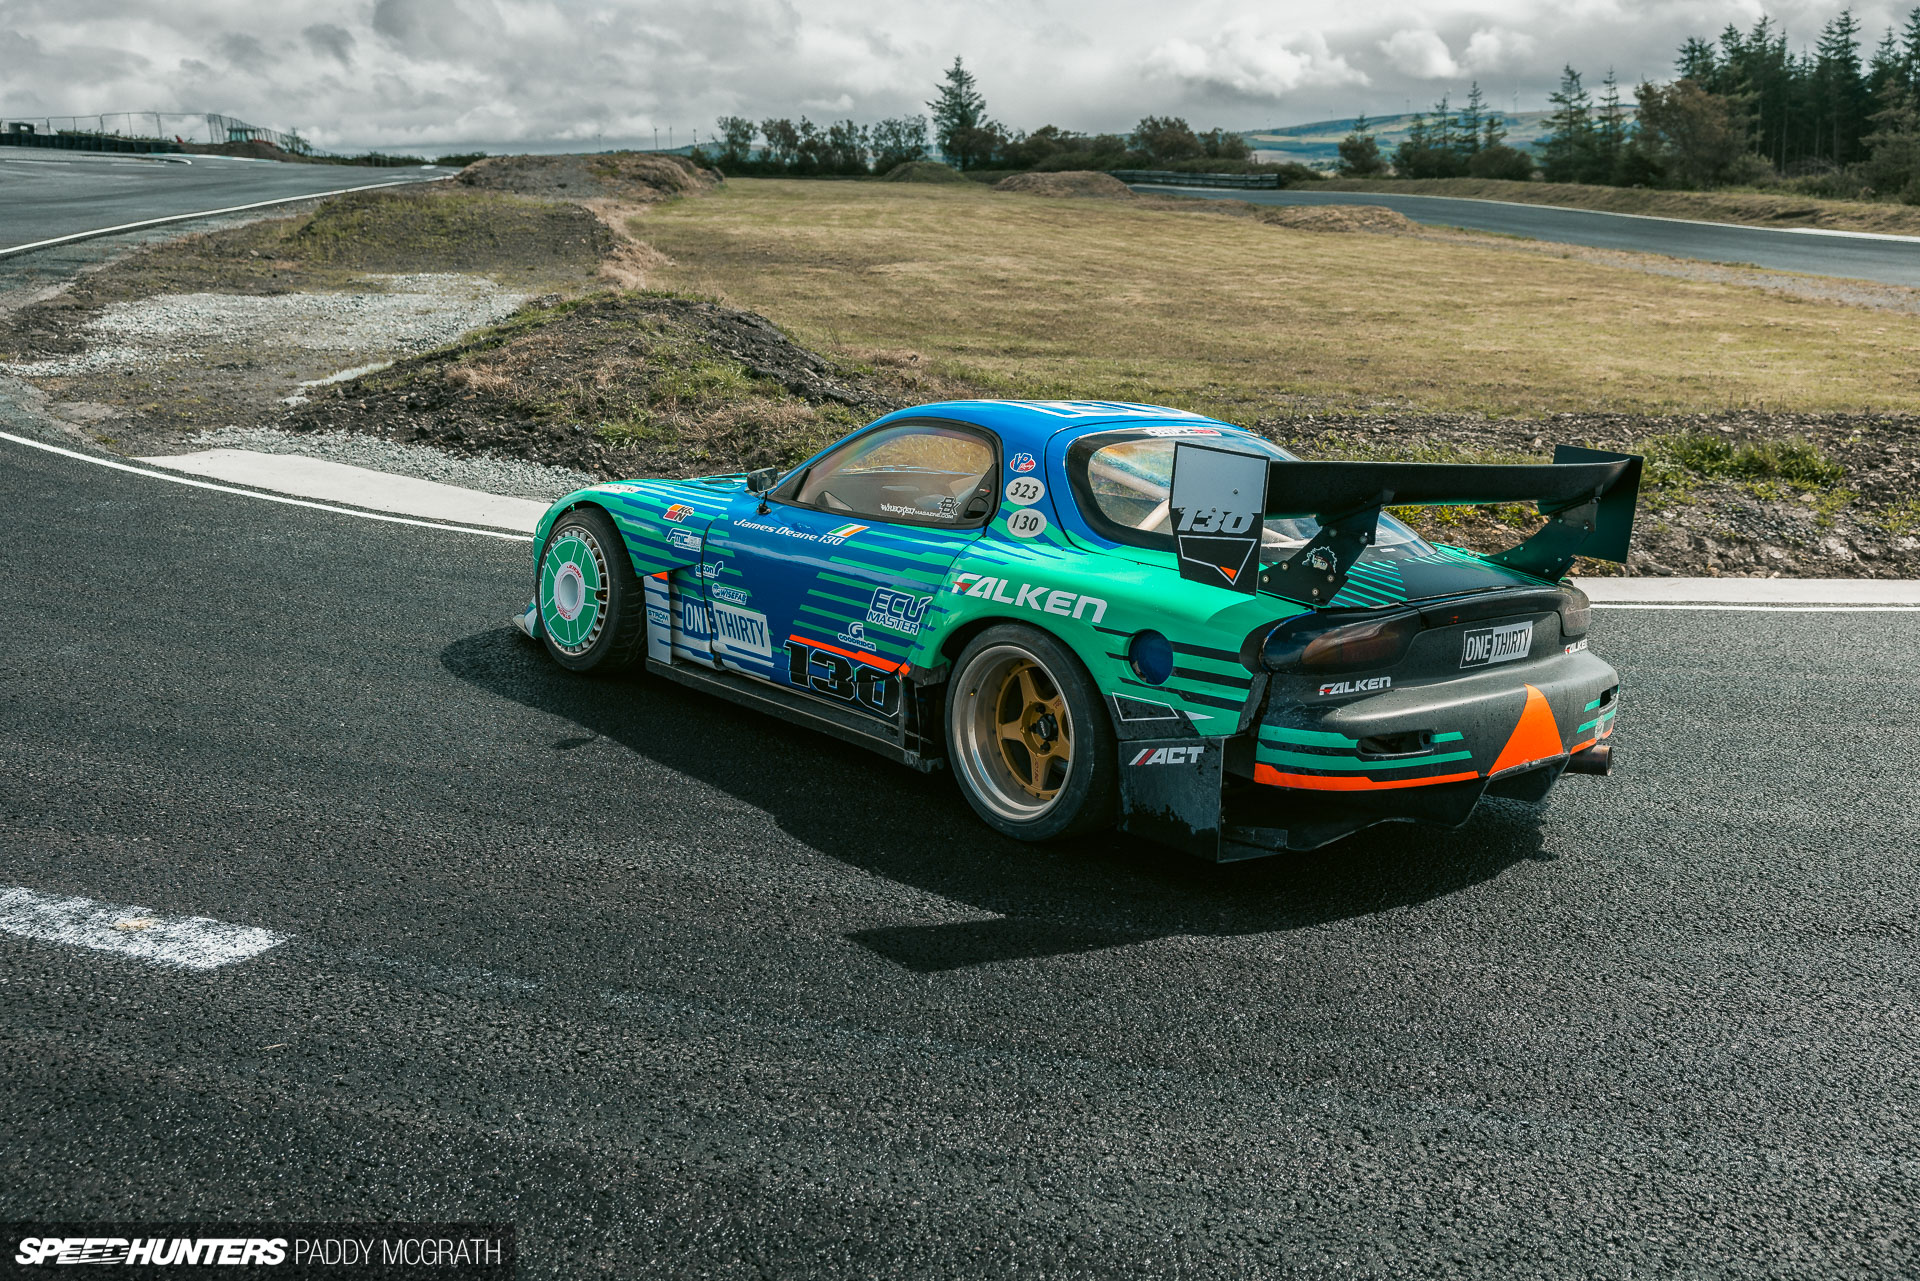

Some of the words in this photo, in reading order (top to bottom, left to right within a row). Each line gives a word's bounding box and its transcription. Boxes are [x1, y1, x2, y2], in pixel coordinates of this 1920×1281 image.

[1013, 453, 1032, 471] VP
[1011, 482, 1039, 500] 323
[733, 518, 777, 533] James
[775, 526, 818, 542] Deane
[818, 534, 845, 546] 130
[1012, 514, 1039, 532] 130
[1177, 507, 1255, 534] 130
[870, 586, 933, 622] ECU
[952, 572, 1108, 624] FALKEN
[685, 602, 718, 634] ONE
[715, 610, 766, 648] THIRTY
[848, 622, 864, 639] G
[866, 611, 919, 635] MASTER
[838, 634, 876, 651] GOODRIDGE
[1465, 634, 1492, 660] ONE
[1494, 628, 1530, 657] THIRTY
[783, 639, 900, 717] 130
[1317, 676, 1391, 696] FALKEN
